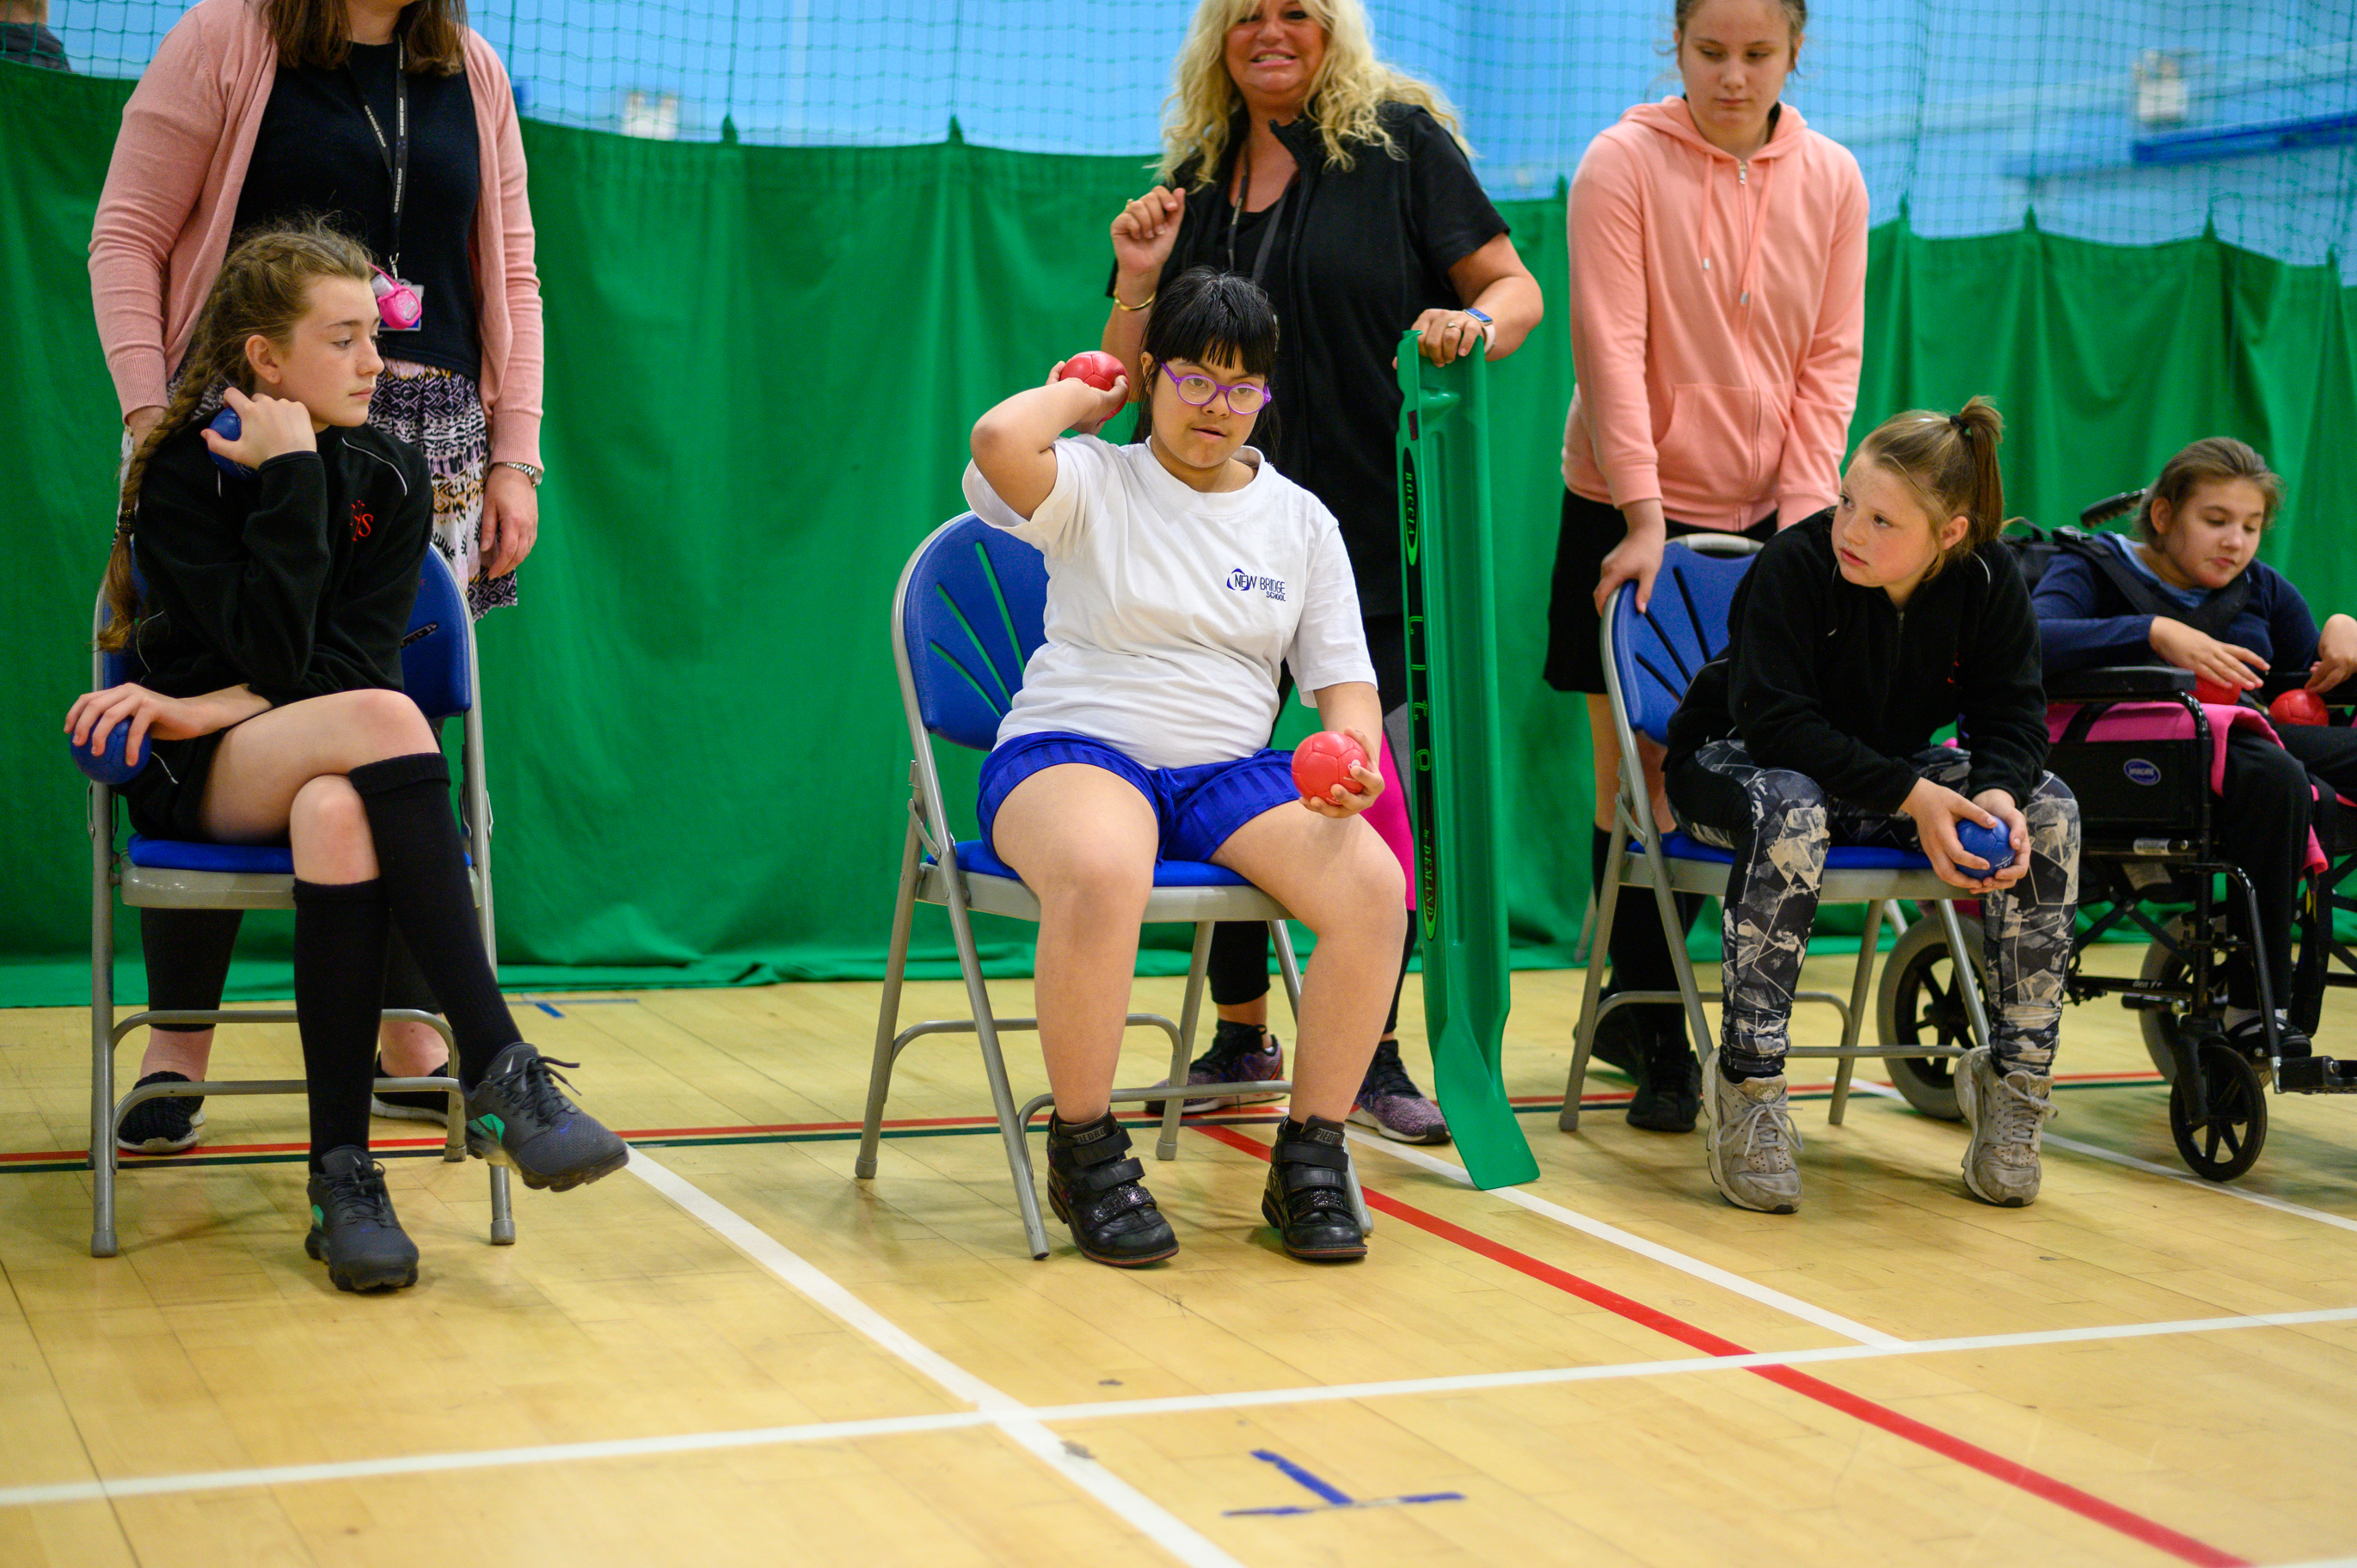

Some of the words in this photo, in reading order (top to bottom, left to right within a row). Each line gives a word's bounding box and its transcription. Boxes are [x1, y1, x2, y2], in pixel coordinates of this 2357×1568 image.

[1405, 472, 1415, 534] BOCCIA
[1235, 573, 1257, 589] NEW
[1260, 577, 1286, 595] BRIDGE
[1266, 591, 1286, 602] SCHOOL
[1424, 844, 1434, 916] DEMAND
